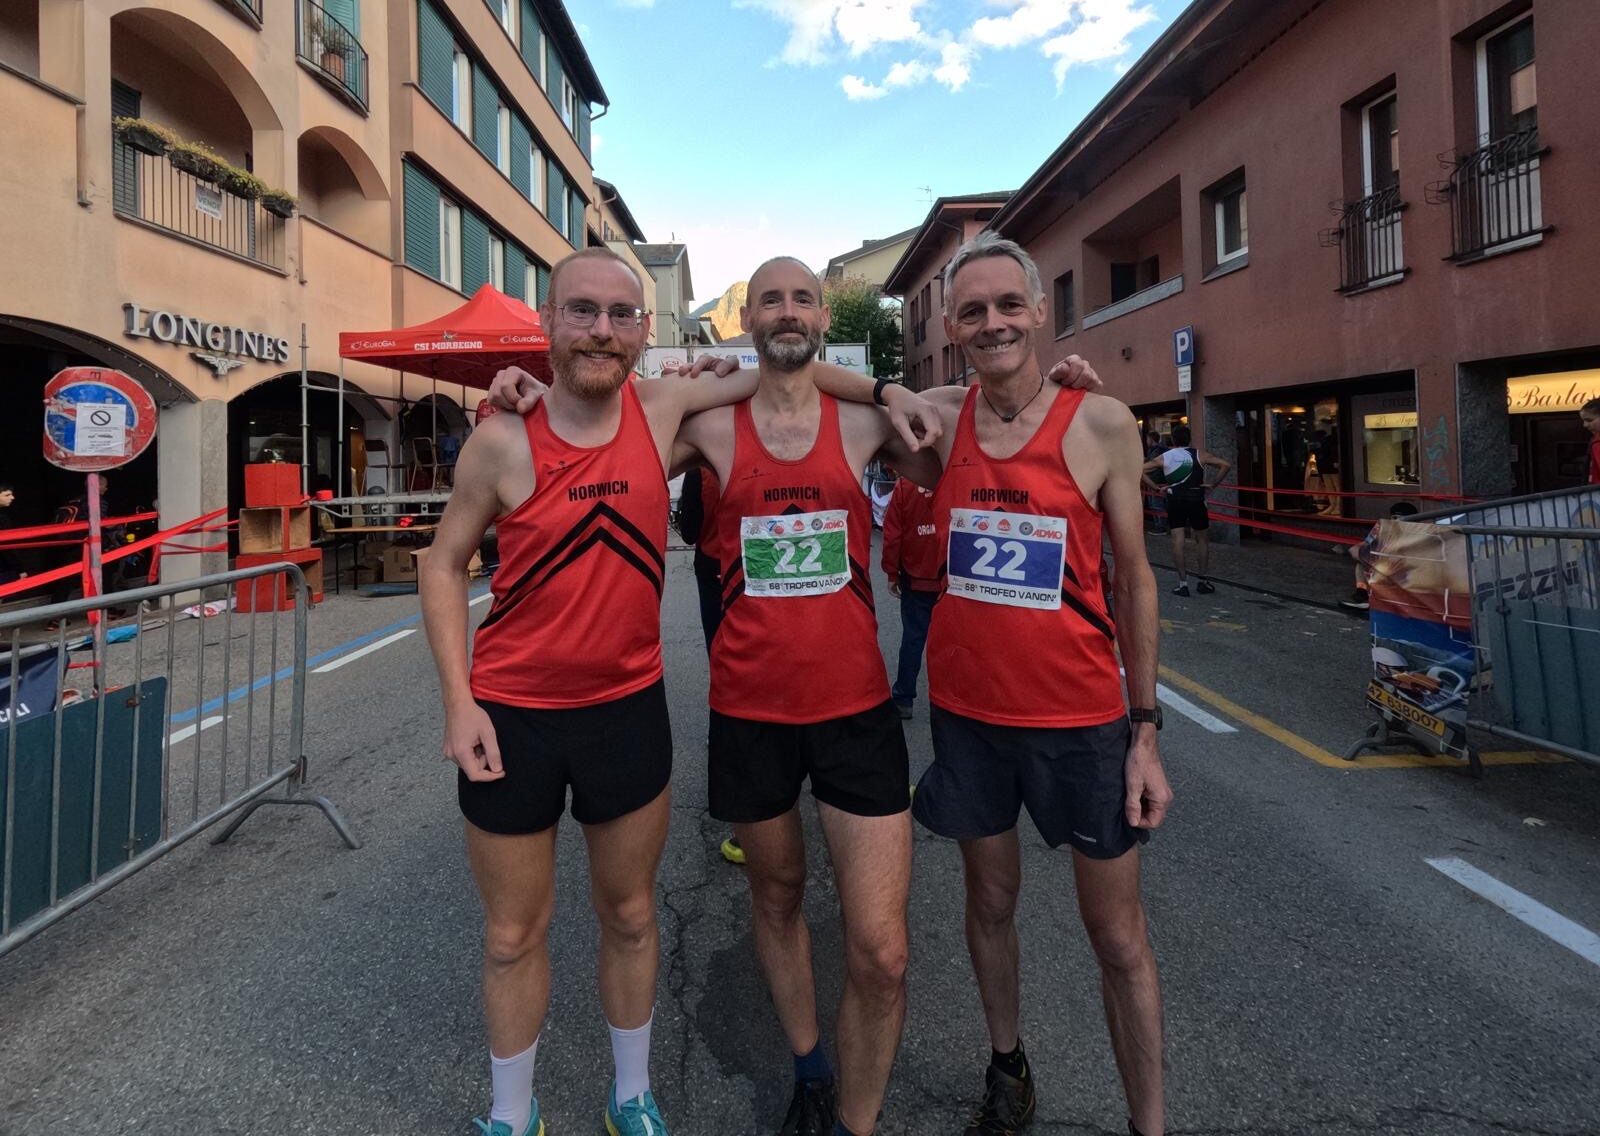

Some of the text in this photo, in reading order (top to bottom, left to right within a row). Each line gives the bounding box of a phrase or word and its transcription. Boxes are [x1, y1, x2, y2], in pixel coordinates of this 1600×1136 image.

[122, 302, 289, 363] LONGINES
[414, 341, 483, 351] CSI MORBEGNO
[1175, 331, 1190, 363] P
[568, 480, 629, 502] HORWICH
[763, 486, 820, 502] HORWICH
[970, 488, 1029, 505] HORWICH
[1032, 529, 1063, 540] ADMO
[773, 540, 822, 574] 22
[970, 537, 1027, 581] 22
[784, 580, 818, 590] TROFEO
[979, 585, 1016, 598] TROFEO
